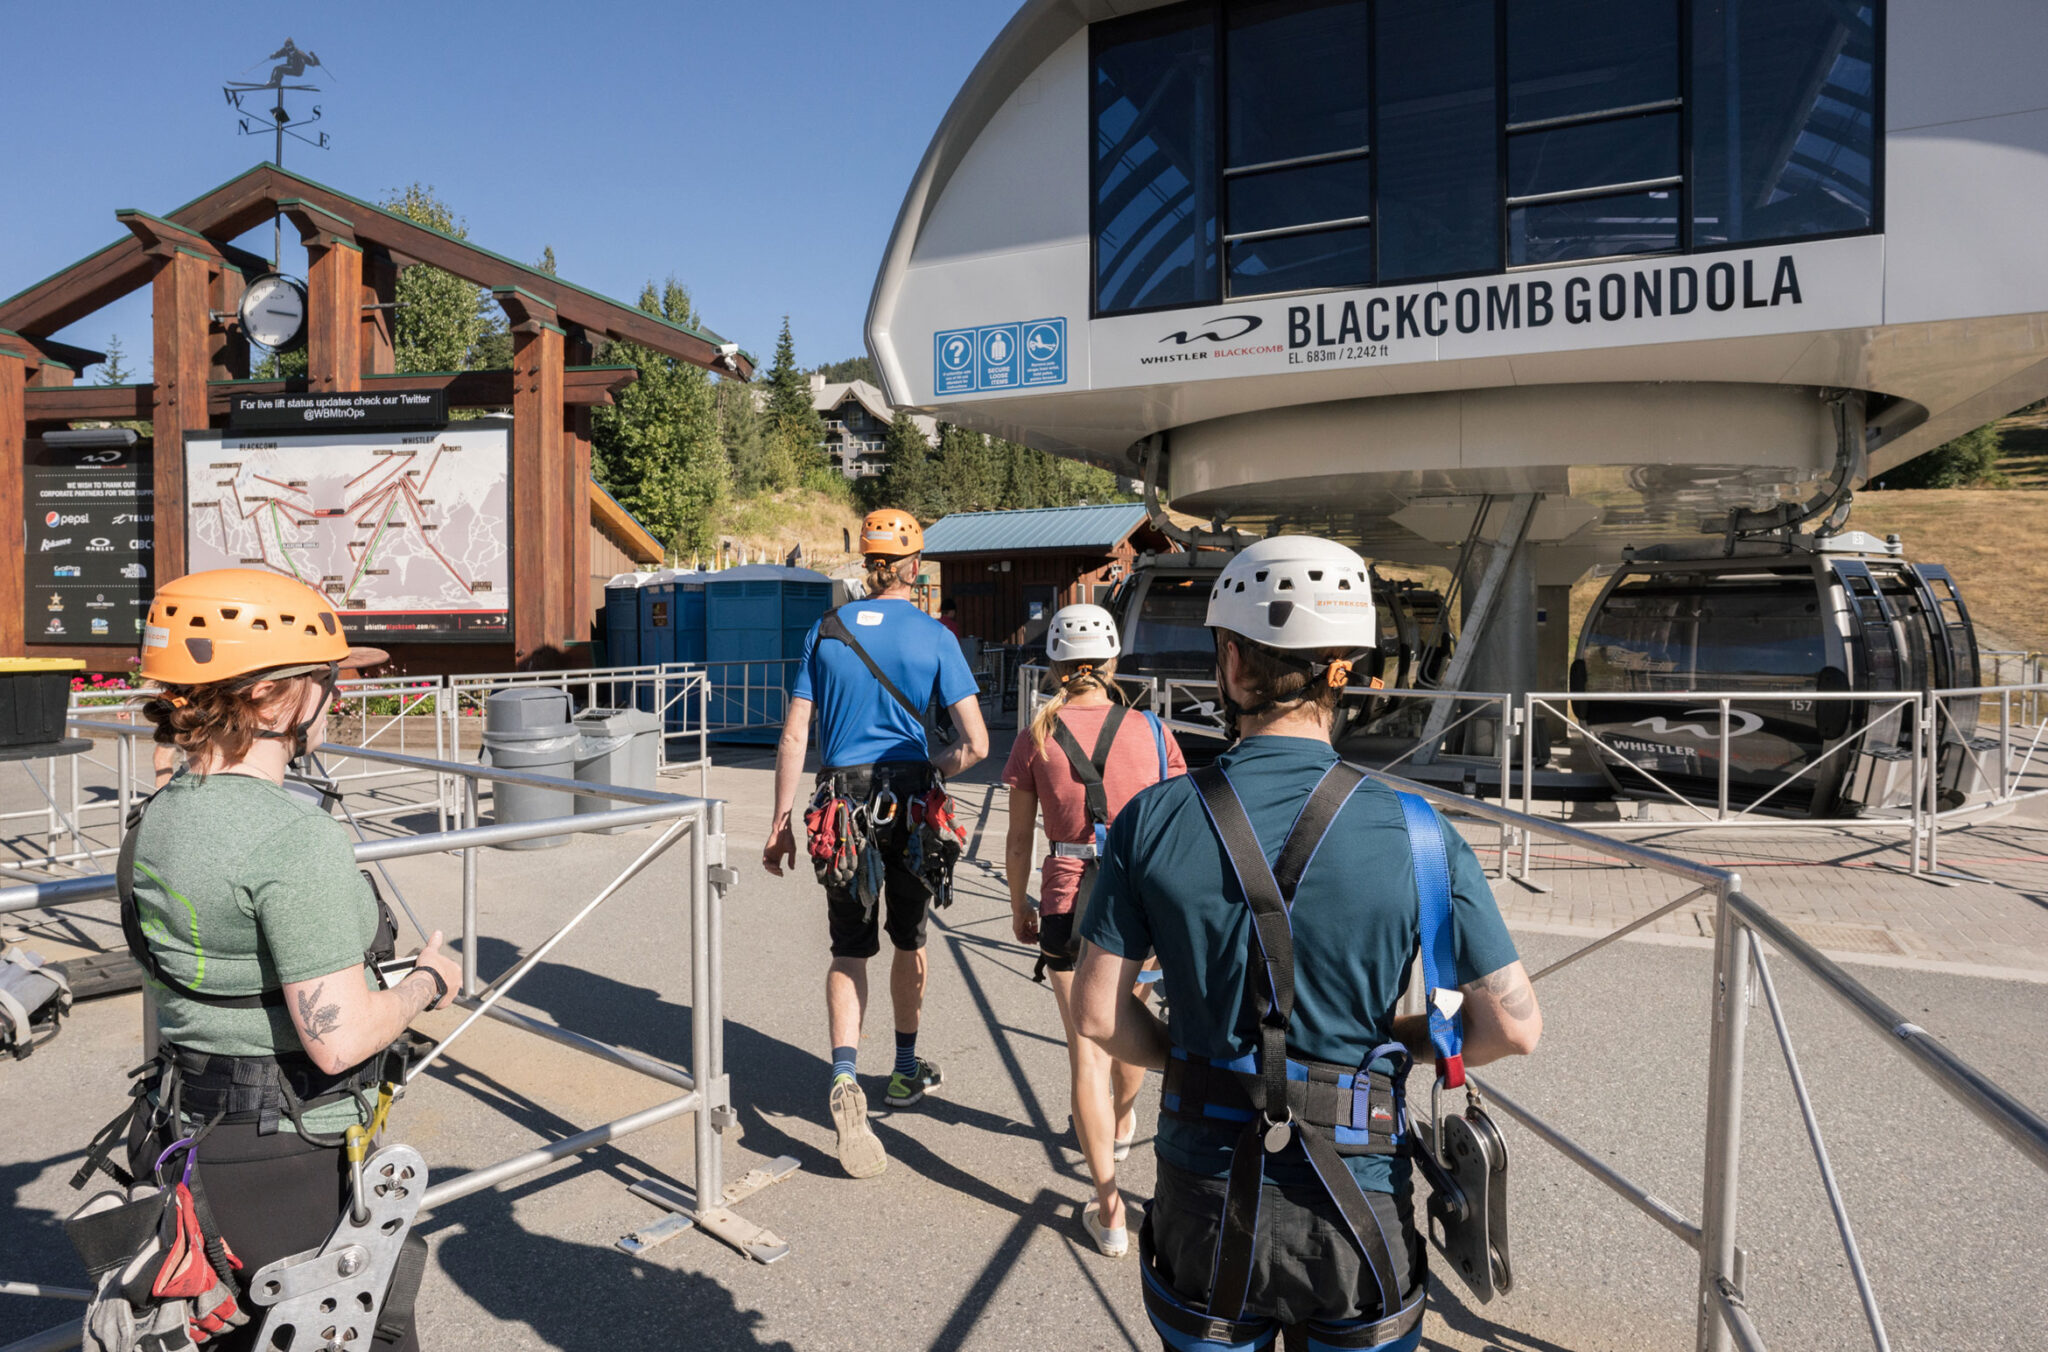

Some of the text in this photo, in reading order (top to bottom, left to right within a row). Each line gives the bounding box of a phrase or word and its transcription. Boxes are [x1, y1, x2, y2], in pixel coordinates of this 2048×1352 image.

[311, 105, 322, 121] S
[238, 118, 250, 136] N
[319, 131, 330, 150] E
[1288, 255, 1803, 349] BLACKCOMB GONDOLA
[1141, 345, 1284, 365] WHISTLER BLACKCOMB
[1288, 352, 1304, 364] EL.
[1306, 350, 1336, 363] 683m
[1346, 347, 1377, 360] 2,242
[1380, 344, 1388, 357] ft
[988, 366, 1010, 374] SECURE
[240, 394, 431, 410] For live lift status updates check our Twitter
[303, 407, 365, 421] @WBMtnOps
[239, 442, 278, 451] BLACKCOMB
[402, 436, 435, 445] WHISTLER
[60, 513, 89, 525] pepsi
[1790, 700, 1813, 711] 157
[1613, 740, 1697, 757] WHISTLER
